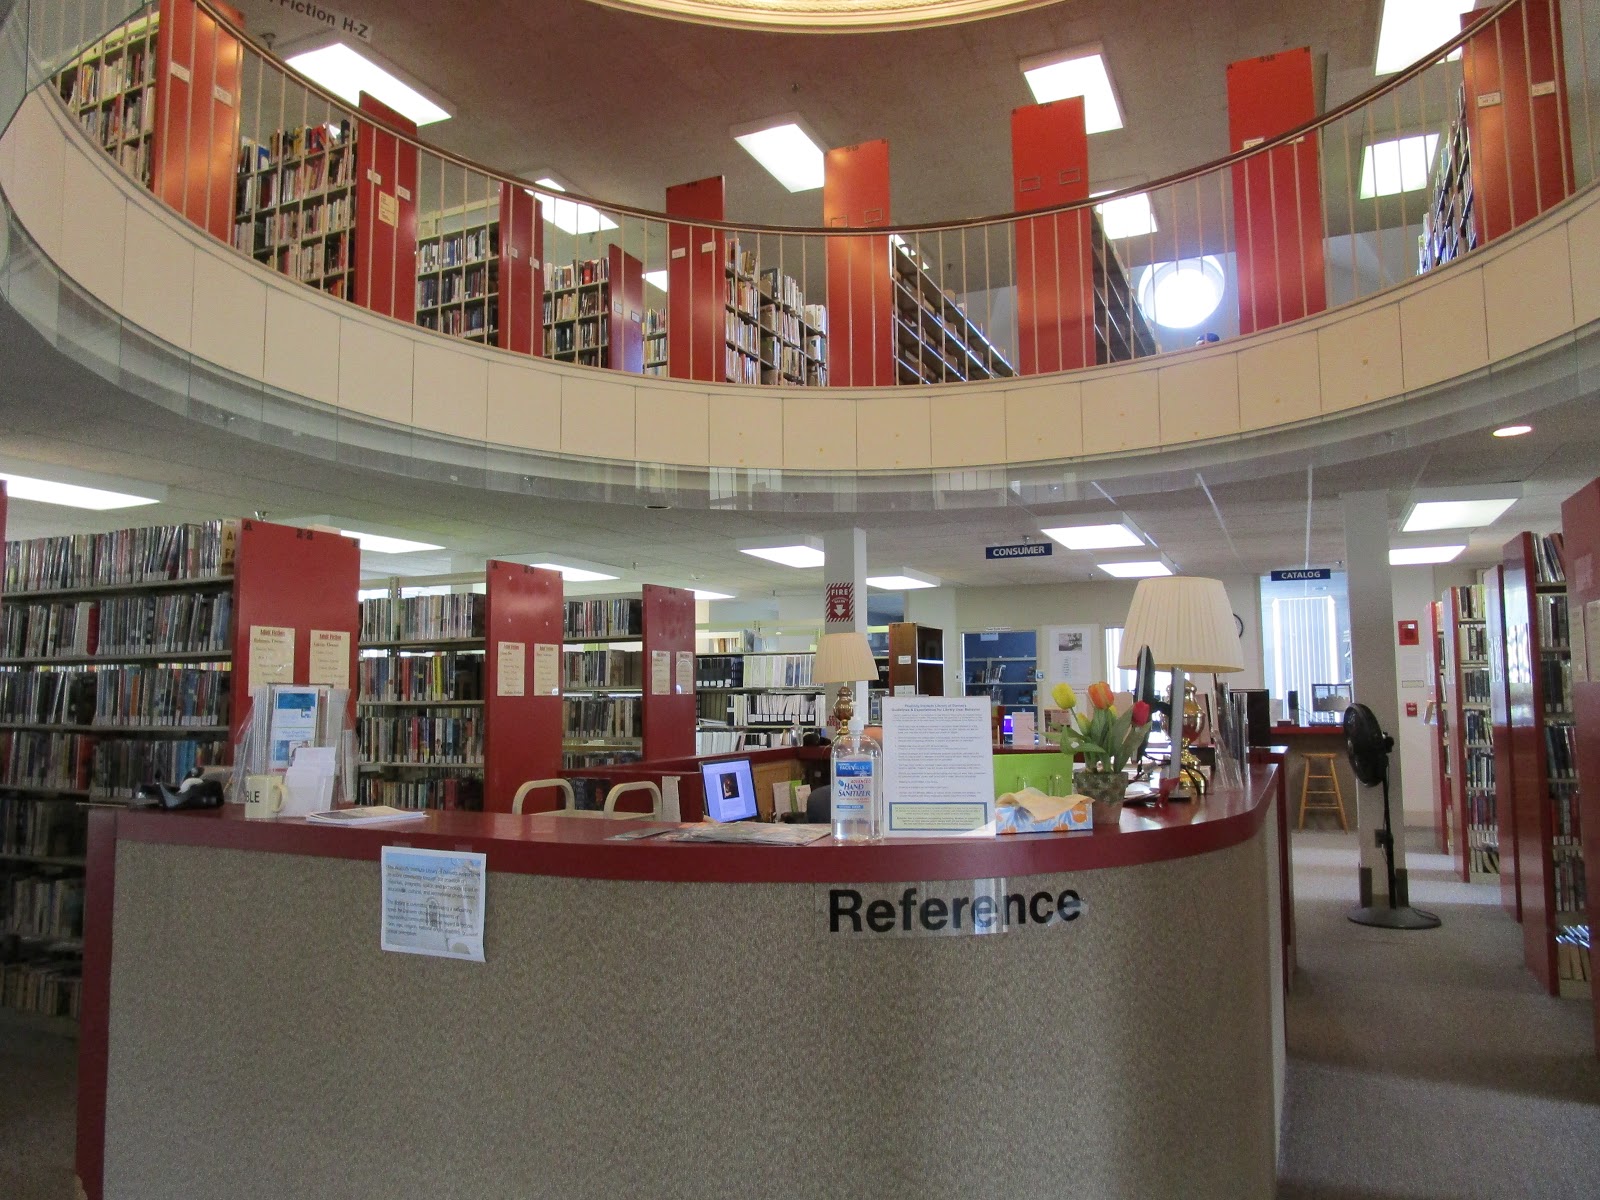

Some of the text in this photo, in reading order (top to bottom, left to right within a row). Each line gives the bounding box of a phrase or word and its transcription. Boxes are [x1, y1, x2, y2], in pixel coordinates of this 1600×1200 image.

[342, 17, 369, 38] H-Z
[993, 546, 1045, 557] CONSUMER
[1281, 571, 1321, 580] CATALOG
[831, 588, 849, 596] FIRE
[828, 888, 1082, 933] Reference
